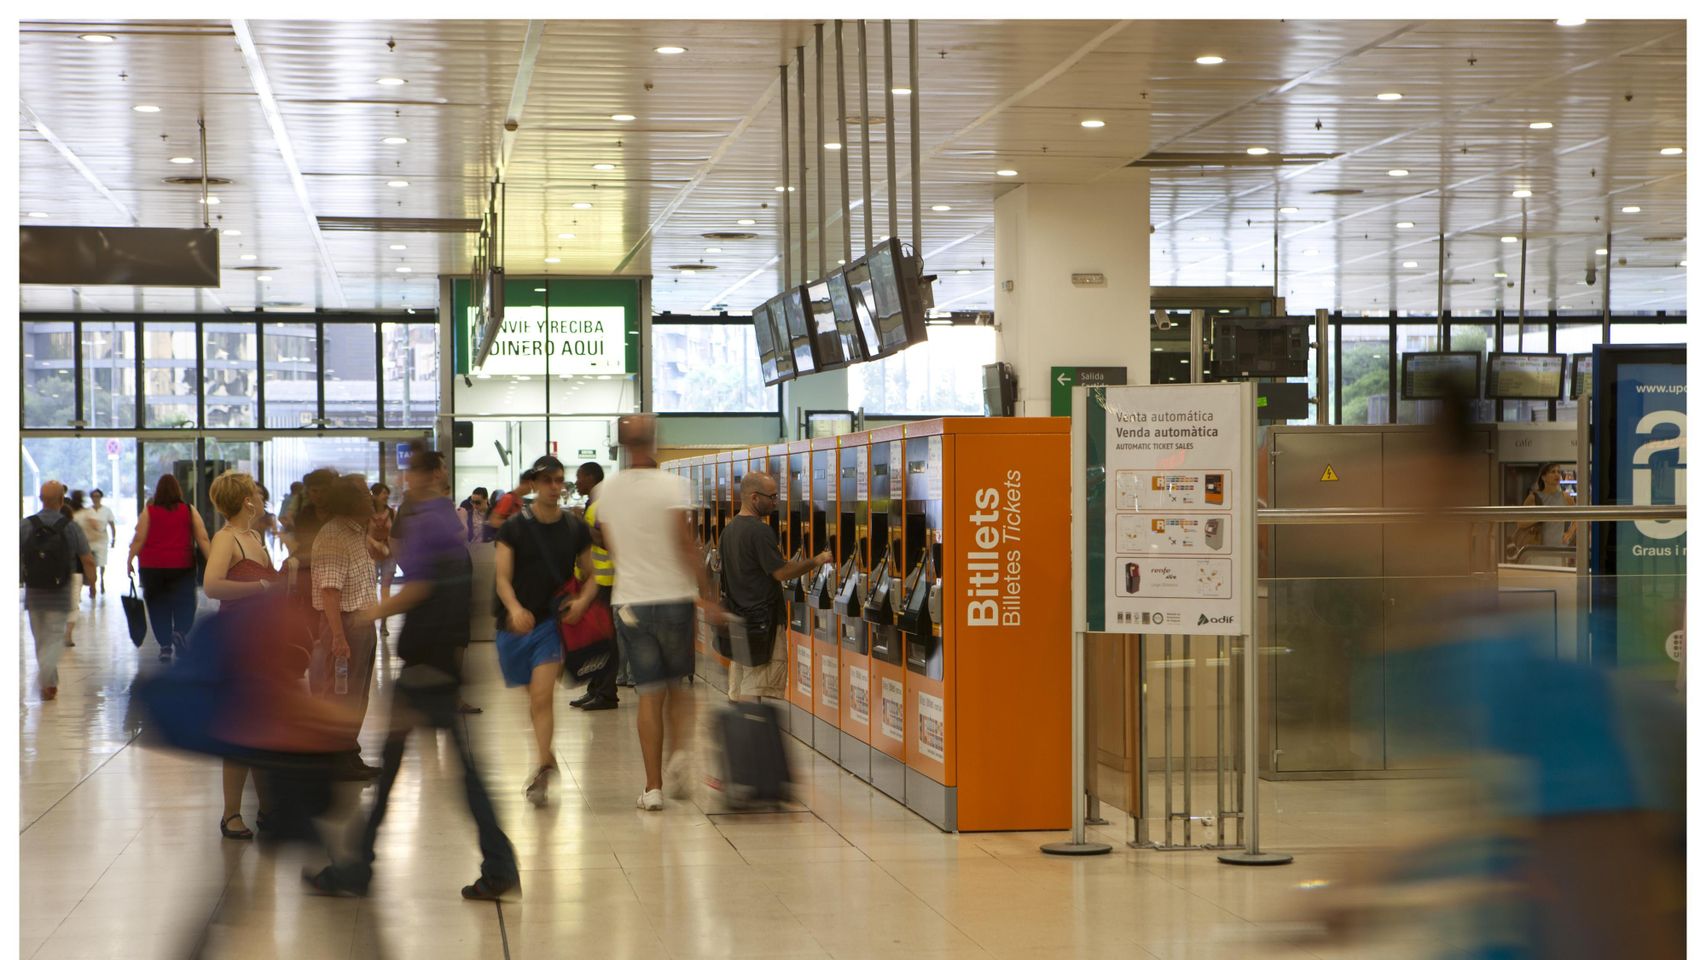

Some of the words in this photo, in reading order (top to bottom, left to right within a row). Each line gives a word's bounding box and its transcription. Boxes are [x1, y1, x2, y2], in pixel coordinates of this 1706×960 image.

[500, 321, 531, 333] NVIE
[537, 321, 546, 333] Y
[550, 321, 604, 334] RECIBA
[489, 340, 555, 356] DINERO
[1080, 372, 1105, 380] Salida
[1116, 412, 1147, 422] Venta
[1151, 410, 1214, 422] automática
[1116, 427, 1151, 438] Venda
[1154, 426, 1218, 438] automàtica
[1175, 442, 1194, 450] SALES
[1002, 469, 1021, 544] Tickets
[1632, 544, 1672, 556] Graus
[1675, 544, 1679, 556] i
[967, 487, 1000, 627] Bitllets
[1002, 550, 1021, 627] Billetes
[1210, 615, 1234, 624] adif
